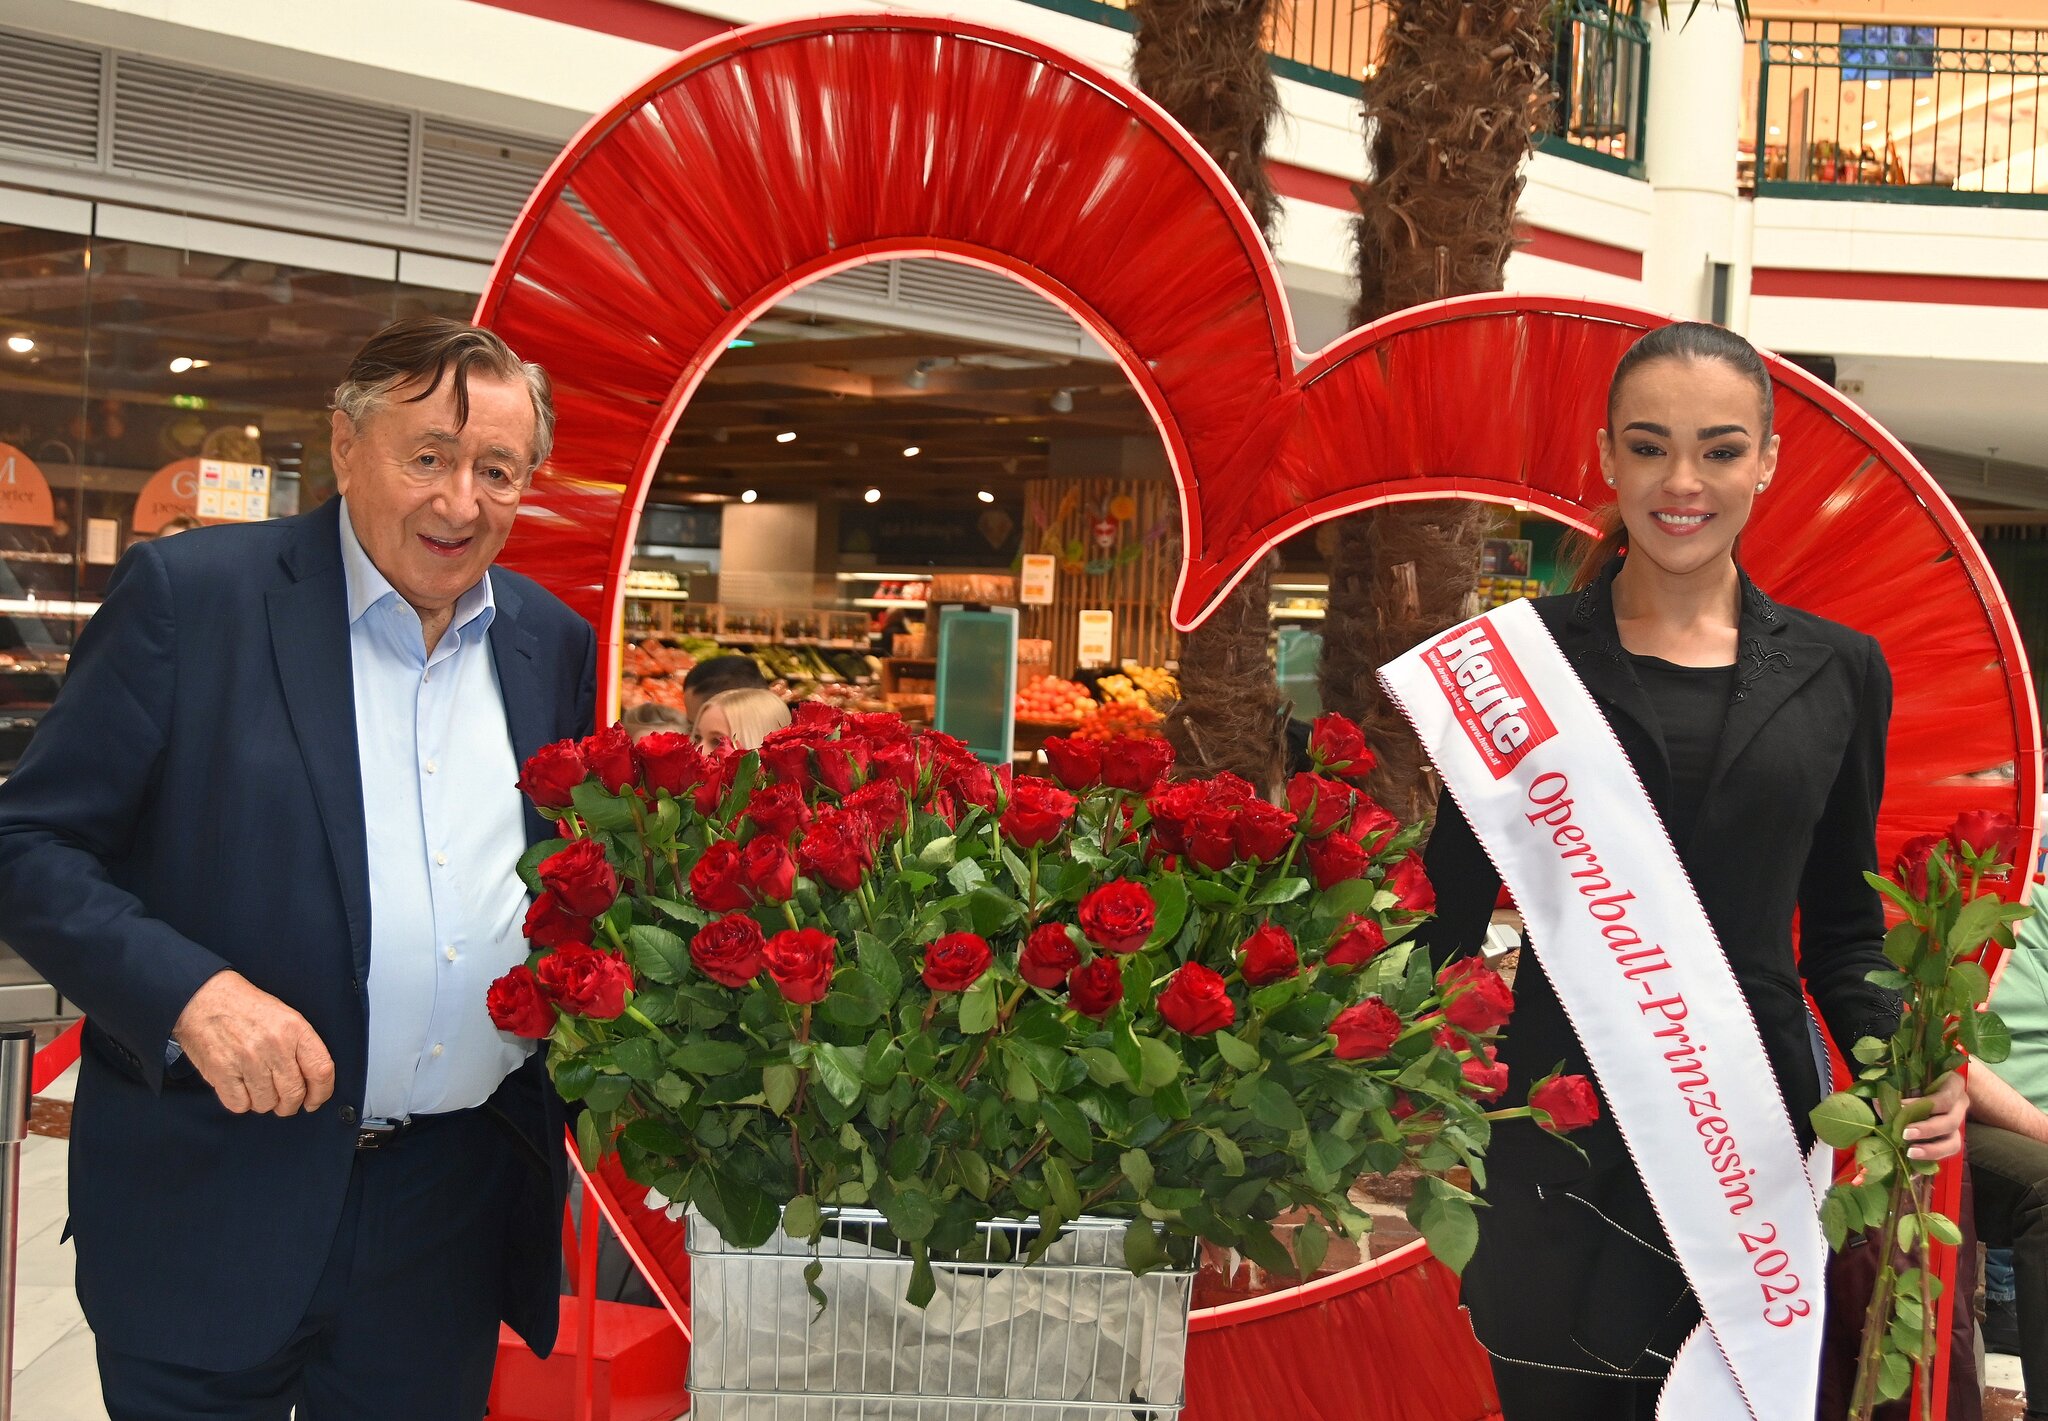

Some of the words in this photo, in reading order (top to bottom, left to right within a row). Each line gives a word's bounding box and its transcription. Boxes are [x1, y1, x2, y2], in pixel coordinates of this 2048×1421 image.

[1437, 626, 1530, 755] Heute
[1465, 718, 1501, 766] www.heute.at
[1526, 771, 1755, 1215] Opernball-Prinzessin
[1738, 1222, 1811, 1327] 2023
